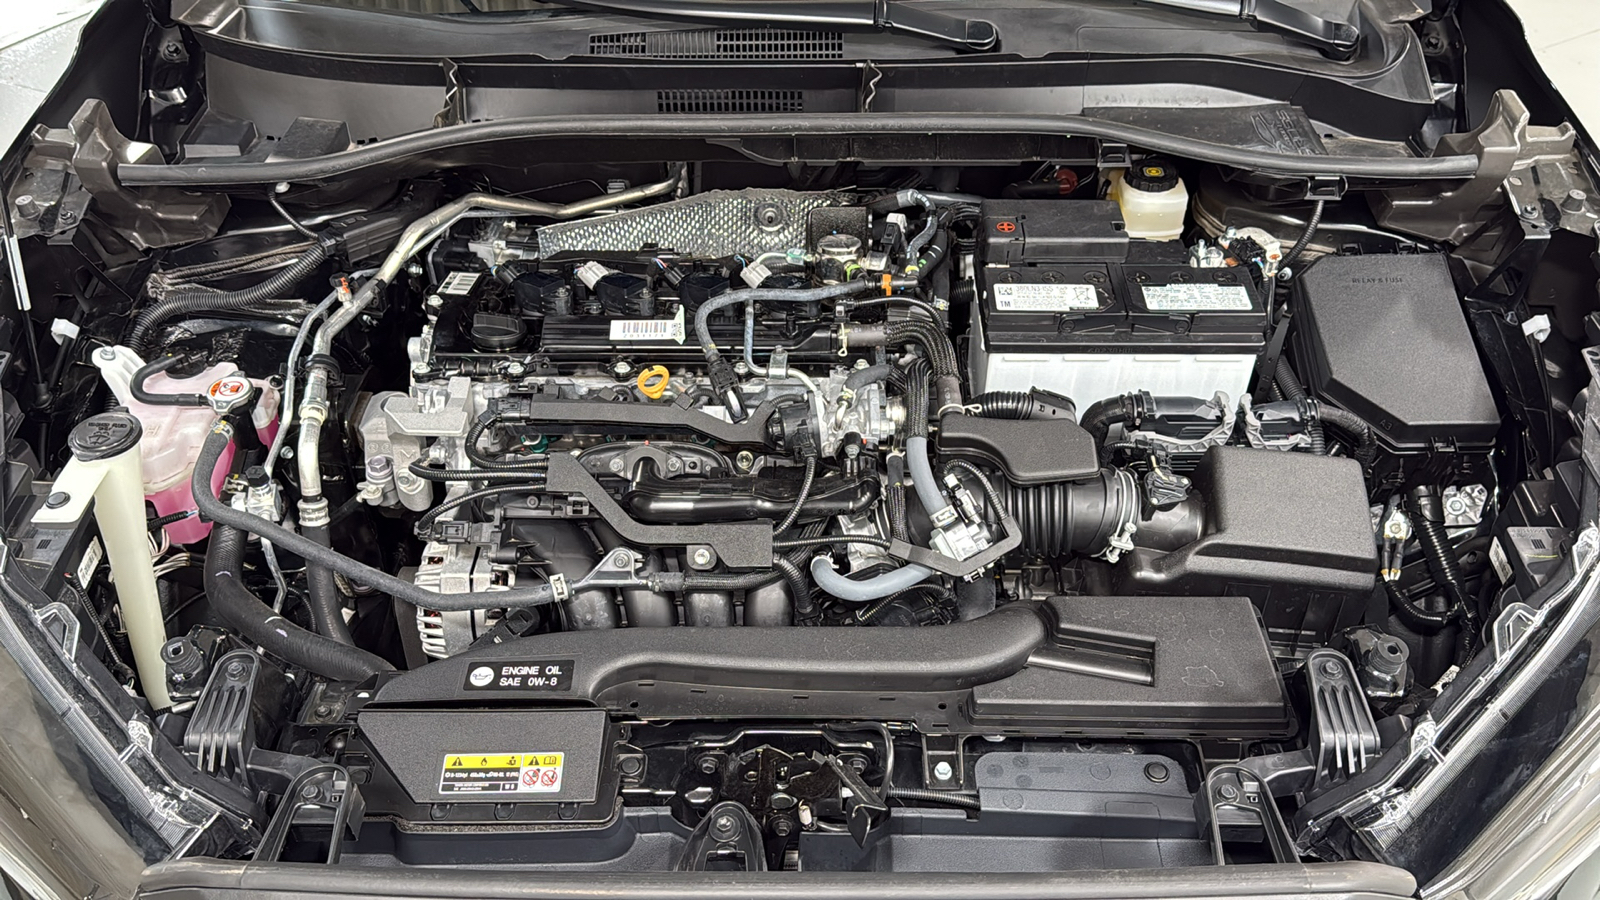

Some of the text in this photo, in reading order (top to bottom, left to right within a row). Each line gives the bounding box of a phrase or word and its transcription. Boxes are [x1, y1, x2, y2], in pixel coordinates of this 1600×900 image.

[501, 665, 562, 675] ENGINE OIL
[499, 677, 558, 686] SAE 0W-8
